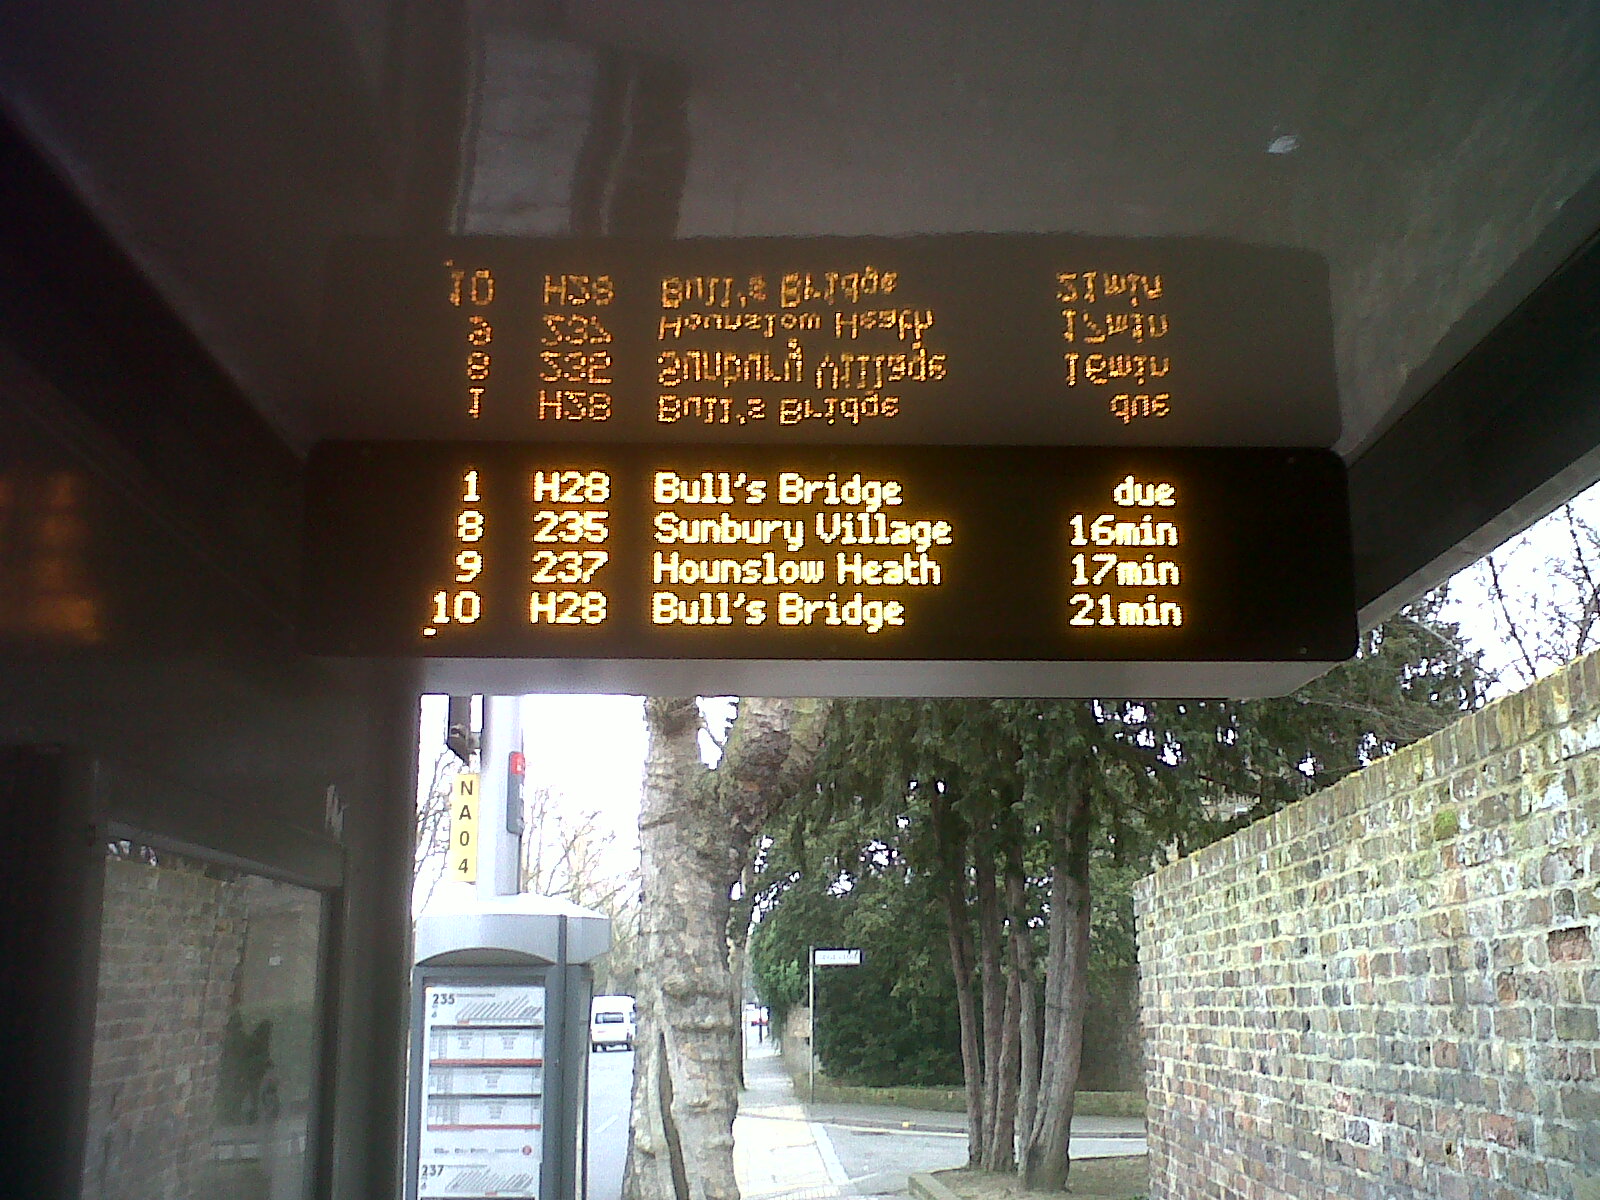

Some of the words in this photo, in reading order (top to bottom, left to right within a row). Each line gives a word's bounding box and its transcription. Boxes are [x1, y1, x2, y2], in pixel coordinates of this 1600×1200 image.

[461, 470, 481, 503] 1
[531, 470, 611, 504] H28
[652, 471, 767, 505] Bull's
[777, 472, 904, 513] Bridge
[1112, 474, 1178, 508] due
[455, 509, 485, 543] 8
[531, 509, 610, 544] 235
[652, 510, 805, 552] Sunbury
[815, 512, 954, 553] Village
[1069, 513, 1180, 547] 16min
[454, 550, 484, 584] 9
[530, 550, 610, 585] 237
[651, 551, 826, 586] Hounslow
[836, 552, 943, 587] Heath
[1070, 552, 1182, 587] 17min
[430, 590, 482, 625] 10
[528, 590, 608, 626] H28
[650, 591, 768, 626] Bull's
[776, 591, 906, 635] Bridge
[1068, 592, 1184, 628] 21min
[457, 779, 474, 875] NA04
[433, 993, 456, 1005] 235
[421, 1165, 444, 1177] 237
